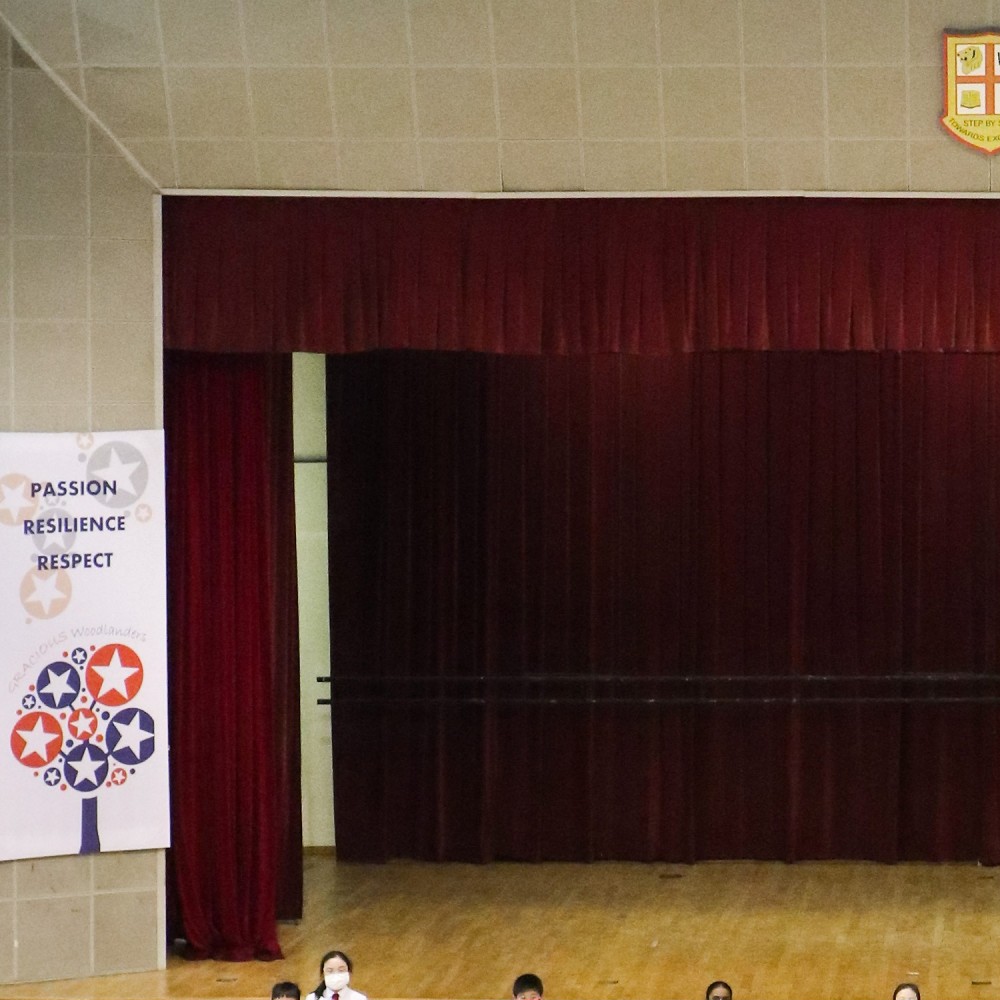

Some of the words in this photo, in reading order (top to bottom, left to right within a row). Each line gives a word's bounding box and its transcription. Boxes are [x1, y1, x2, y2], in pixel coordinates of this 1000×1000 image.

[949, 117, 985, 142] TOWARDS
[963, 119, 984, 128] STEP
[985, 119, 995, 128] BY
[30, 480, 118, 498] PASSION
[23, 516, 126, 535] RESILIENCE
[37, 552, 114, 571] RESPECT
[8, 631, 68, 694] GRACIOUS
[70, 624, 147, 642] Woodlanders
